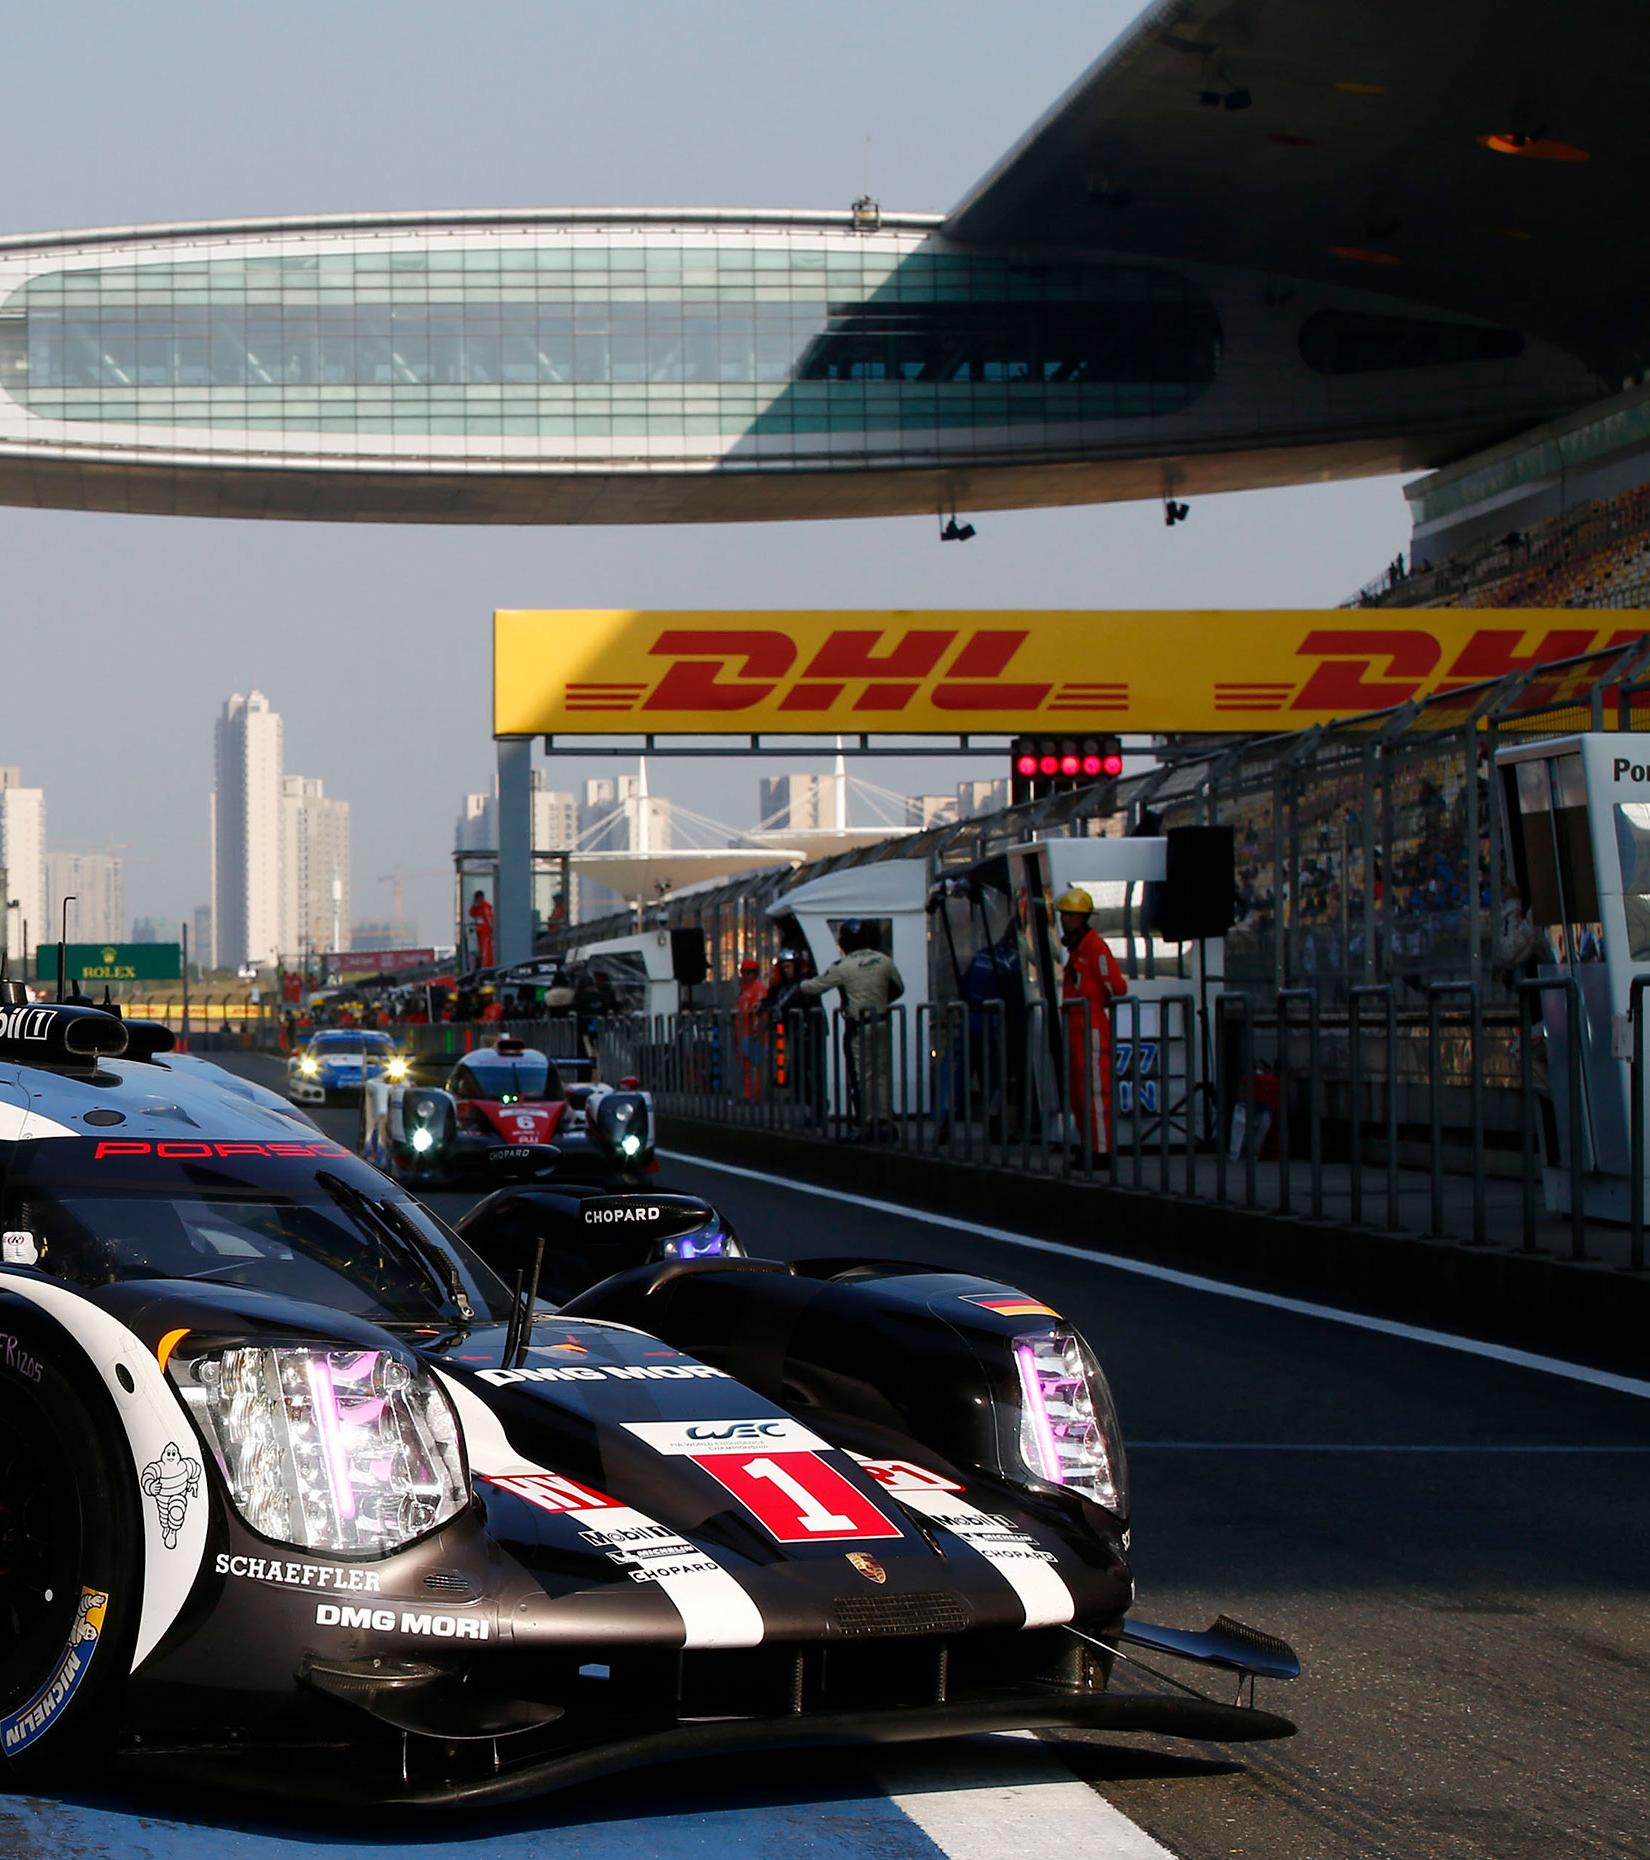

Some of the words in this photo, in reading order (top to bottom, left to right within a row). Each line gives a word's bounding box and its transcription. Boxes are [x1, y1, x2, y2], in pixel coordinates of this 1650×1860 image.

[641, 630, 1053, 711] DHL
[82, 966, 136, 978] ROLEX
[515, 1116, 536, 1130] 6
[489, 1148, 531, 1160] CHOPARD
[584, 1205, 660, 1225] CHOPARD
[473, 1367, 608, 1387] DMG
[685, 1423, 786, 1440] WEC
[490, 1475, 609, 1510] HY
[742, 1457, 858, 1533] 1
[931, 1514, 992, 1527] Mobil
[582, 1527, 652, 1545] Mobil
[982, 1534, 1033, 1542] MICHELIN
[637, 1545, 695, 1558] MICHELIN
[981, 1550, 1056, 1563] CHOPARD
[215, 1554, 381, 1591] SCHAEFFLER
[632, 1562, 719, 1581] CHOPARD
[315, 1603, 396, 1631] DMG
[400, 1612, 490, 1640] MORI
[5, 1652, 82, 1748] MICHELIN
